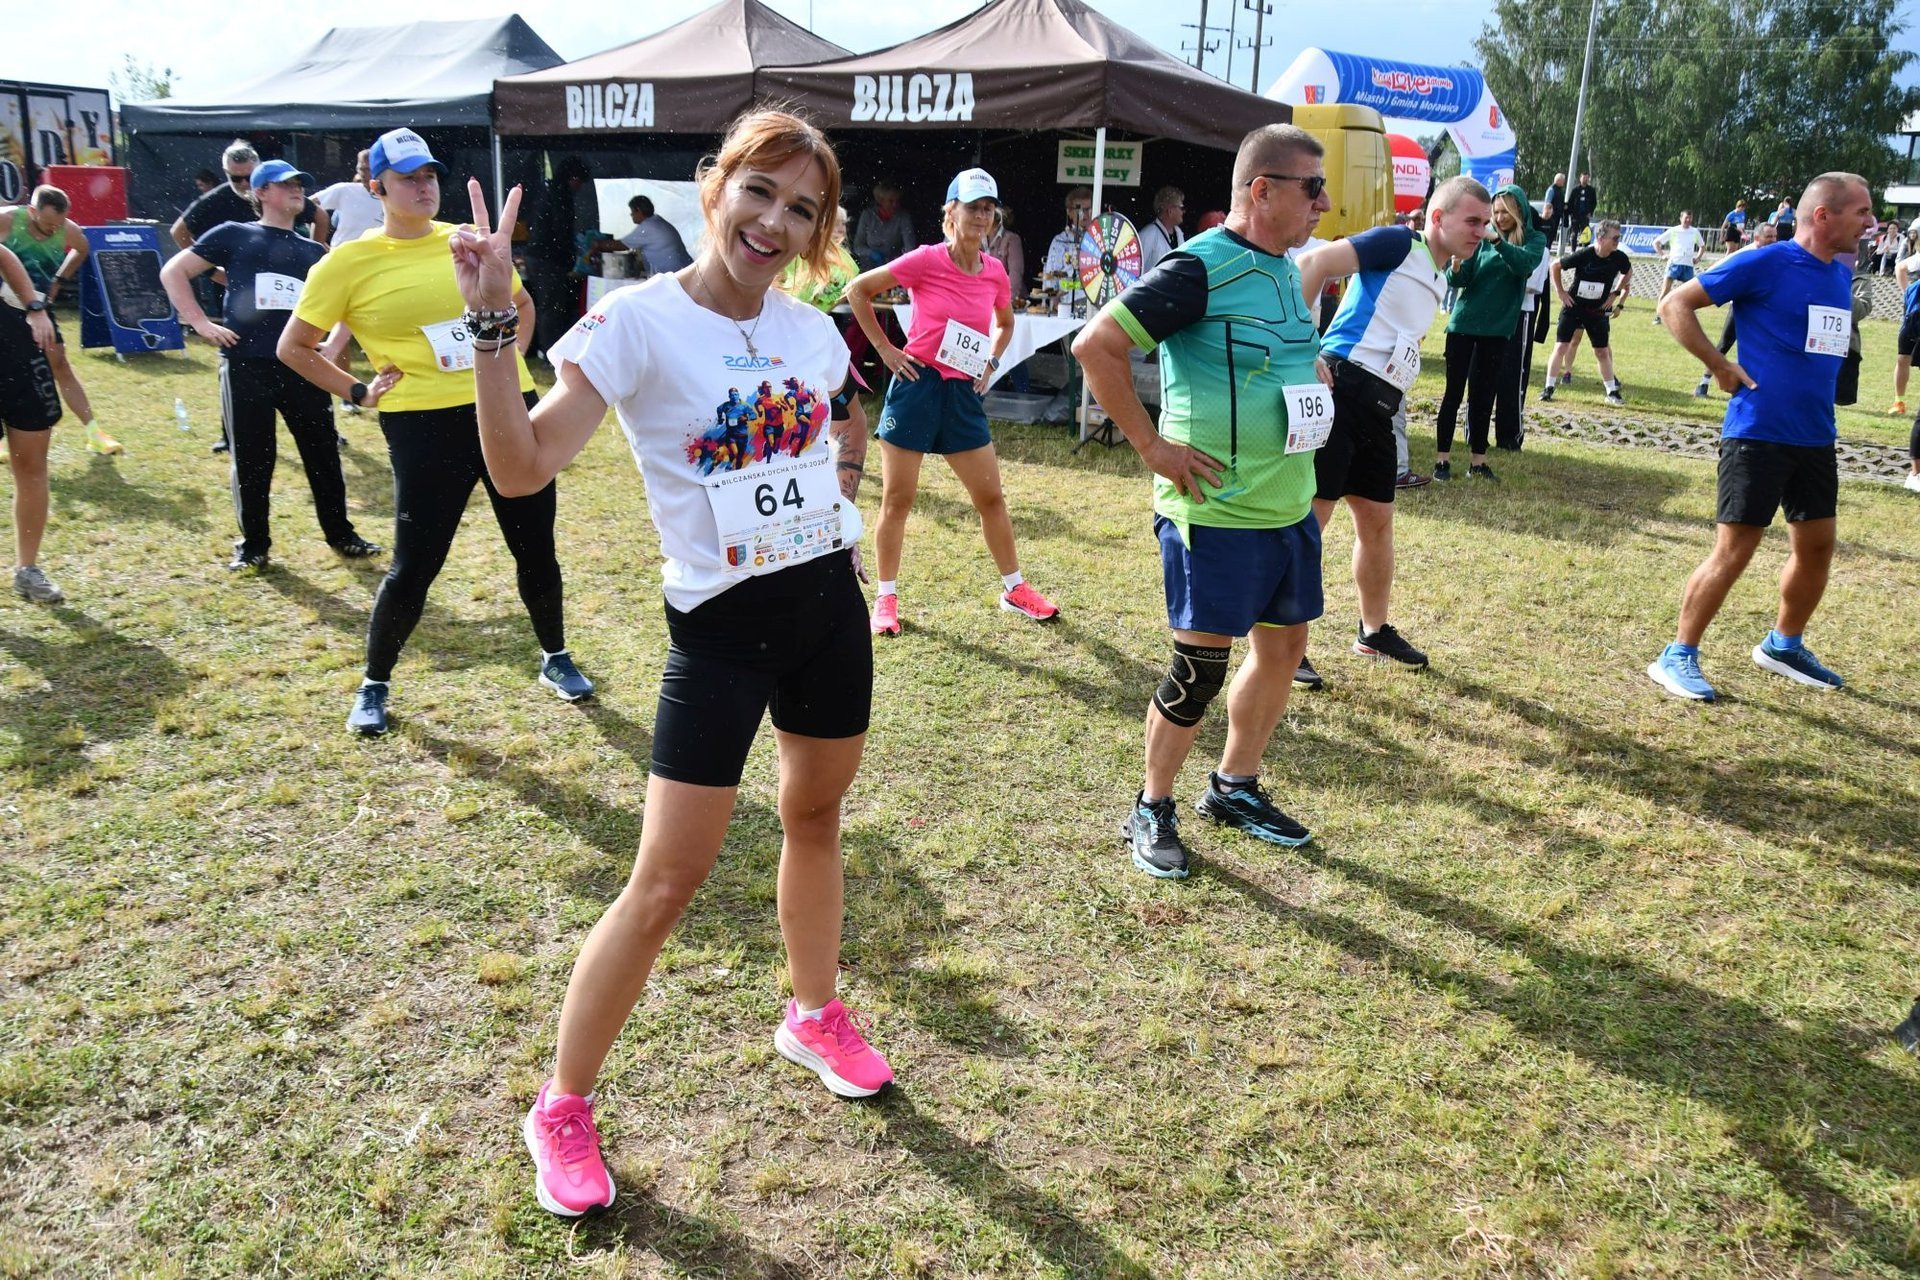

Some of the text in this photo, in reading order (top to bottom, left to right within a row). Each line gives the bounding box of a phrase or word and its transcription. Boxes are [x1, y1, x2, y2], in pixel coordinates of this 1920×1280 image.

[565, 82, 655, 129] BILCZA
[850, 73, 976, 122] BILCZA
[1355, 91, 1385, 104] Miasto
[1391, 96, 1418, 109] Gmina
[1420, 100, 1460, 113] Morawica
[1063, 146, 1135, 160] SENIRZY
[1078, 165, 1130, 182] Biczy
[274, 280, 296, 292] 54
[1823, 315, 1843, 332] 178
[956, 332, 981, 354] 184
[1404, 346, 1419, 369] 176
[1298, 396, 1324, 419] 196
[767, 467, 790, 477] DYCHA
[754, 478, 805, 517] 64
